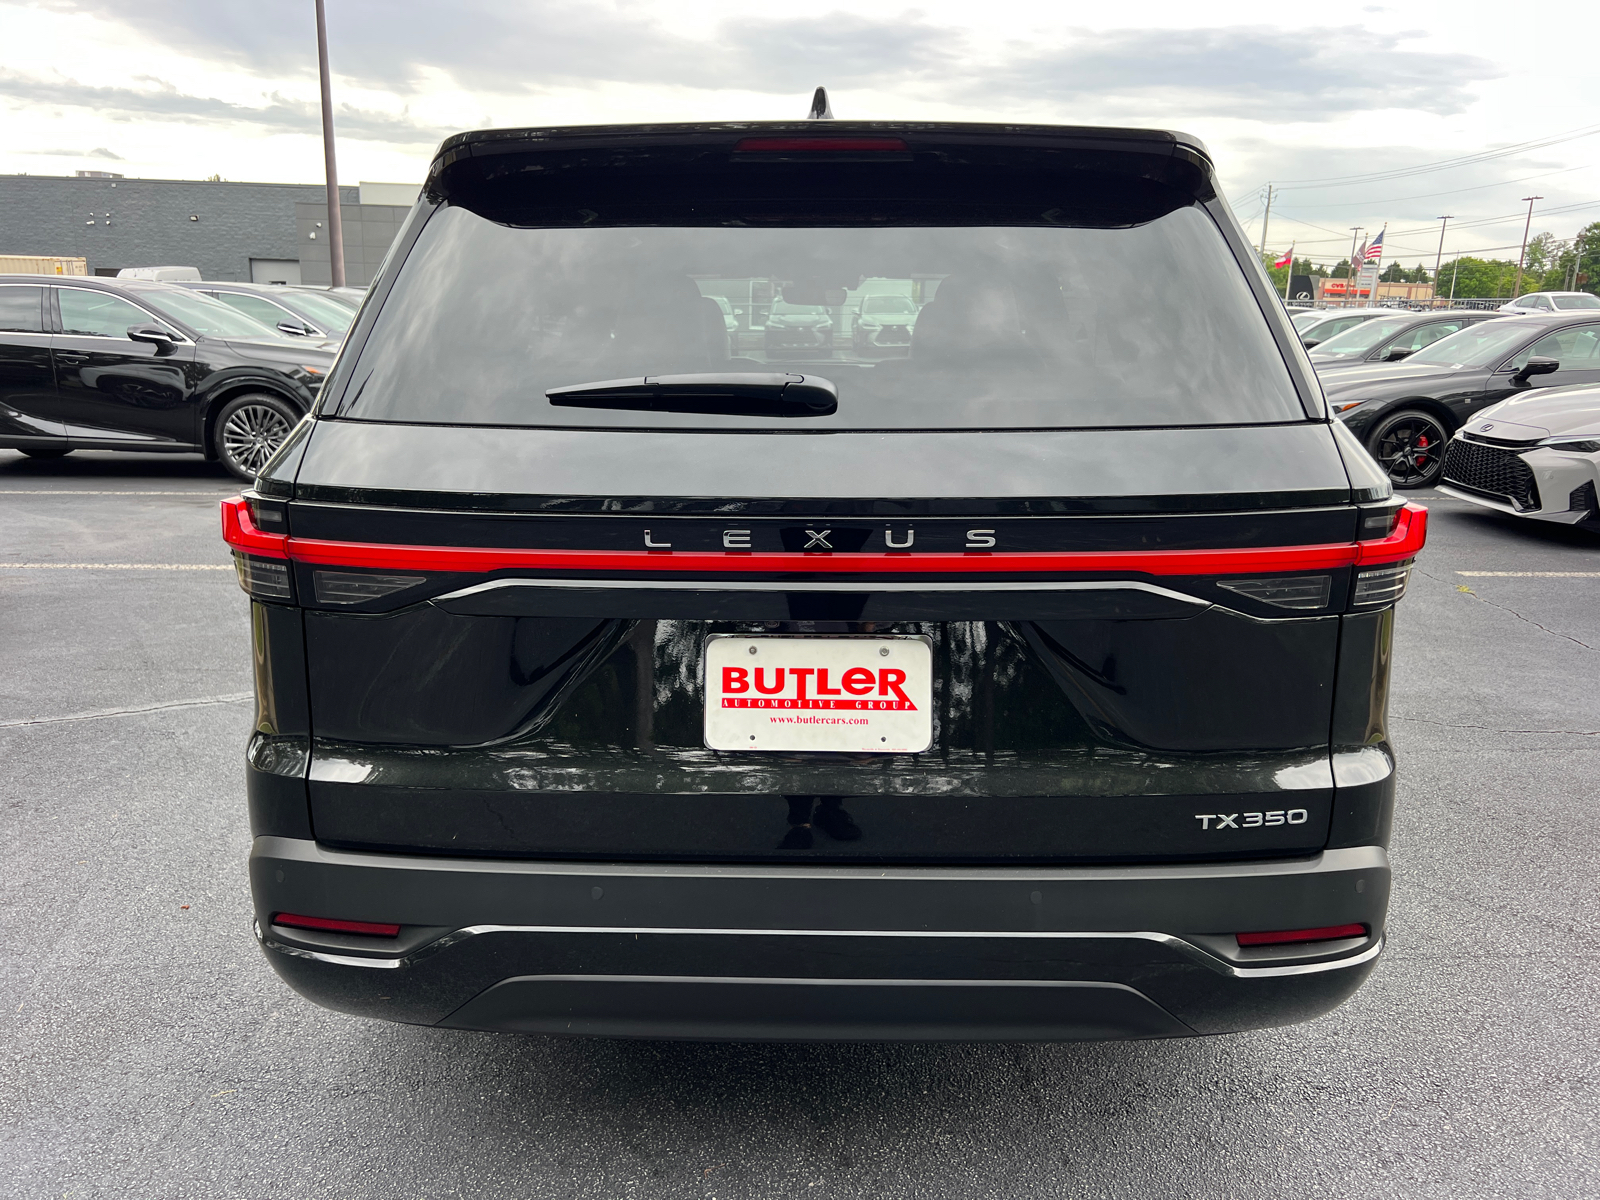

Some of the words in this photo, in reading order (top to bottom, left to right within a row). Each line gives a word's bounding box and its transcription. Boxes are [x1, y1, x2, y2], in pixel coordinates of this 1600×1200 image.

[644, 529, 996, 548] LEXUS
[722, 699, 836, 709] AUTOMOTIVE
[855, 701, 911, 710] GROUP
[769, 716, 869, 725] www.butlercars.com
[1195, 809, 1308, 830] TX350
